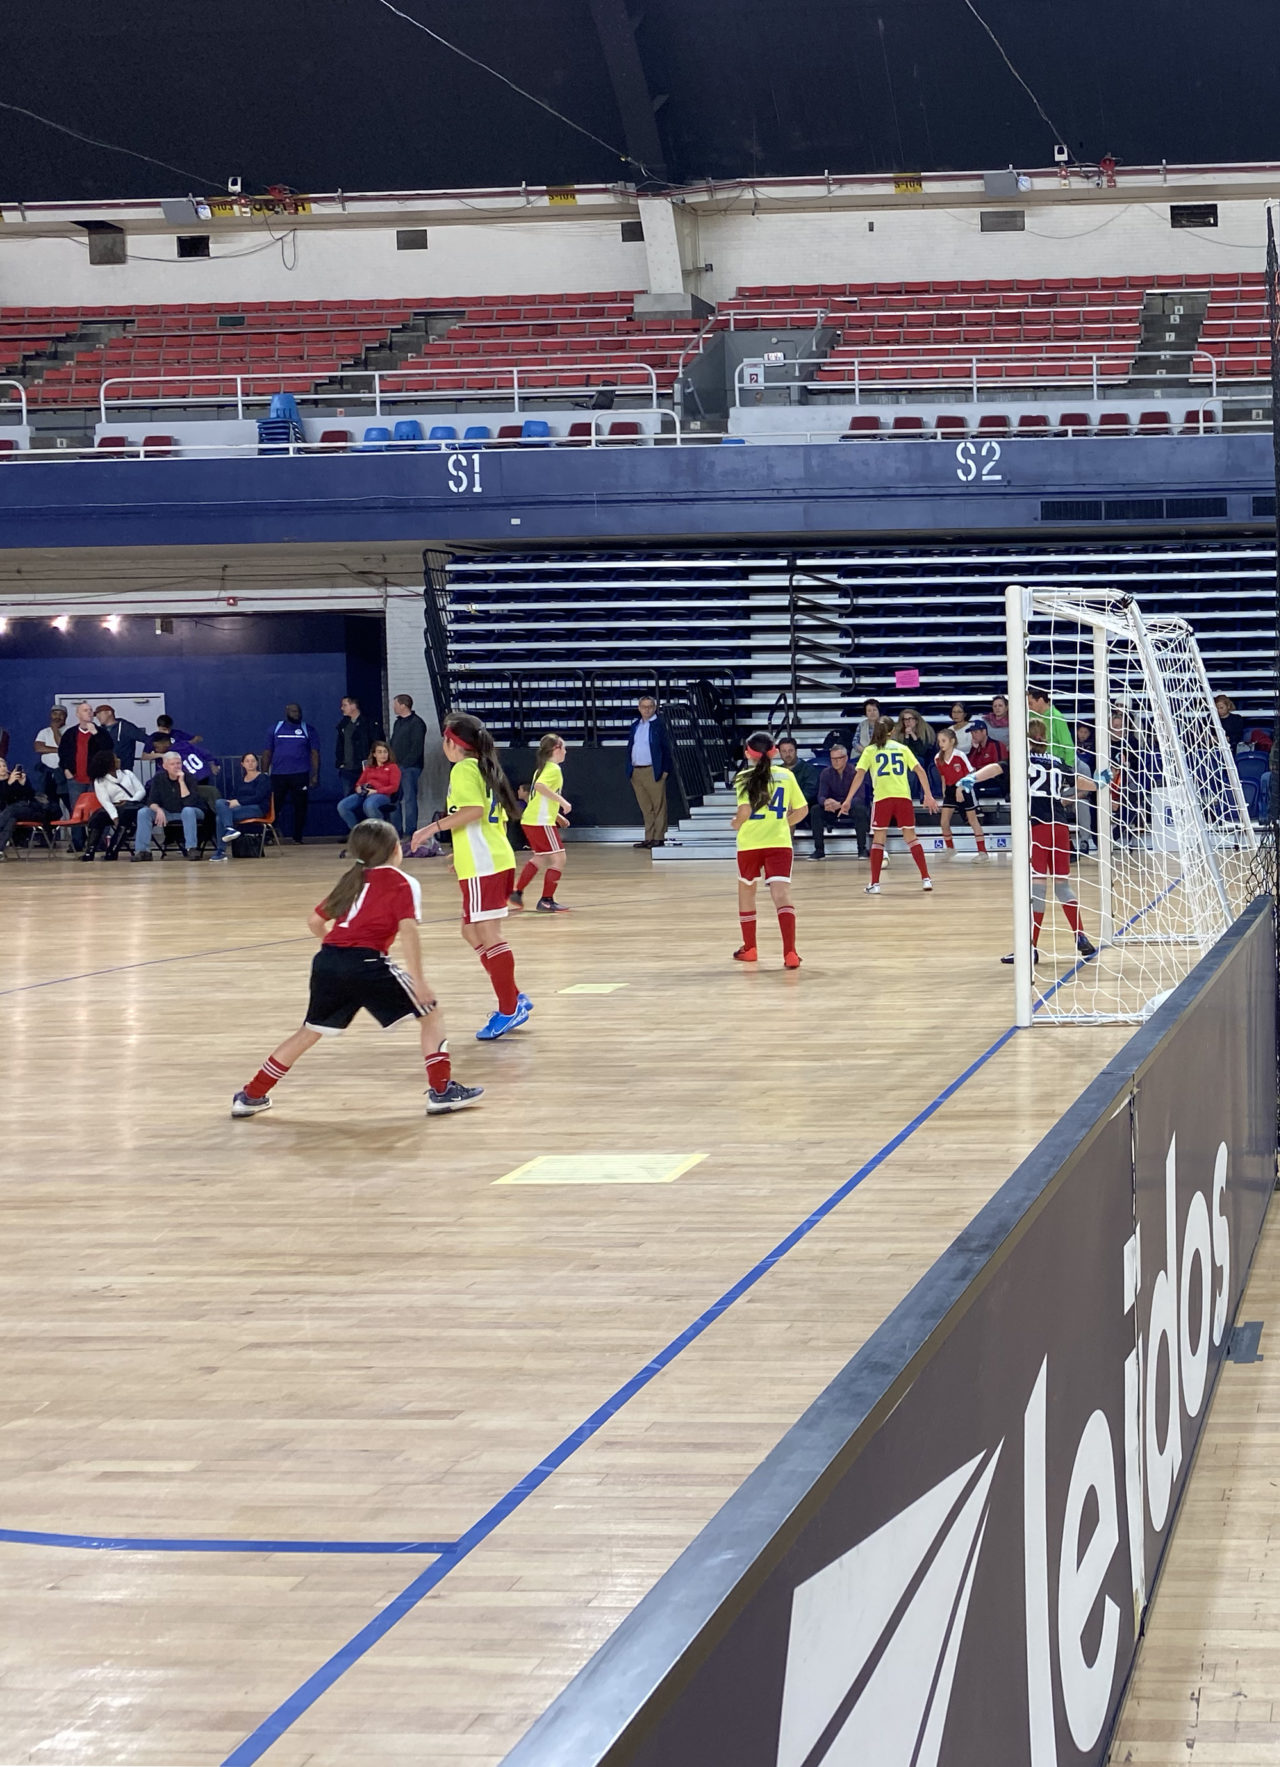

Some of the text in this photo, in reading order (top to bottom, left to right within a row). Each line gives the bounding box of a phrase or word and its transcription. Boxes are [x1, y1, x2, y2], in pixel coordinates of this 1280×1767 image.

[448, 453, 482, 493] S1
[956, 441, 1002, 481] S2
[183, 753, 204, 775] 10
[875, 752, 905, 777] 25
[1028, 763, 1062, 800] 20
[1024, 1131, 1230, 1767] leidos
